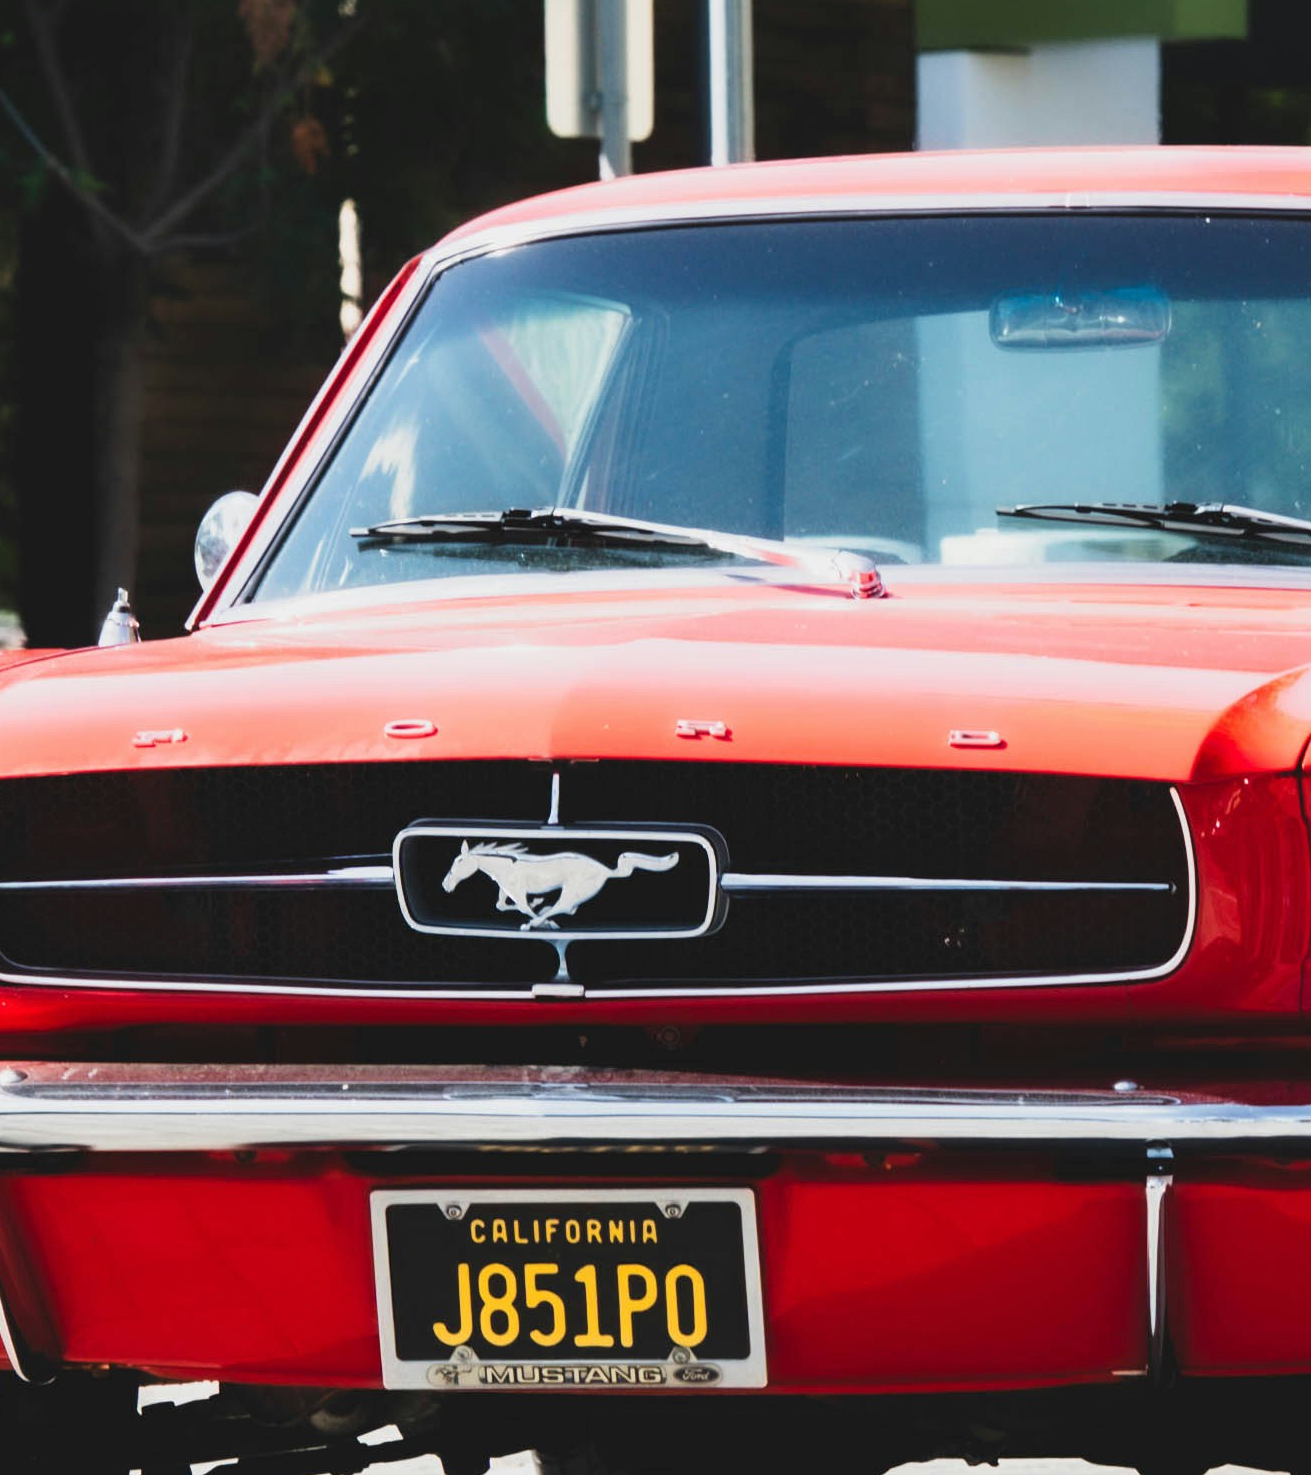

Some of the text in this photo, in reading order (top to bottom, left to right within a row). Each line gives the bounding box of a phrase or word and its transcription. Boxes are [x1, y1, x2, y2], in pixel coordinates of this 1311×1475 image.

[470, 1218, 658, 1245] CALIFORNIA
[486, 1365, 710, 1384] MUSTANG Ford
